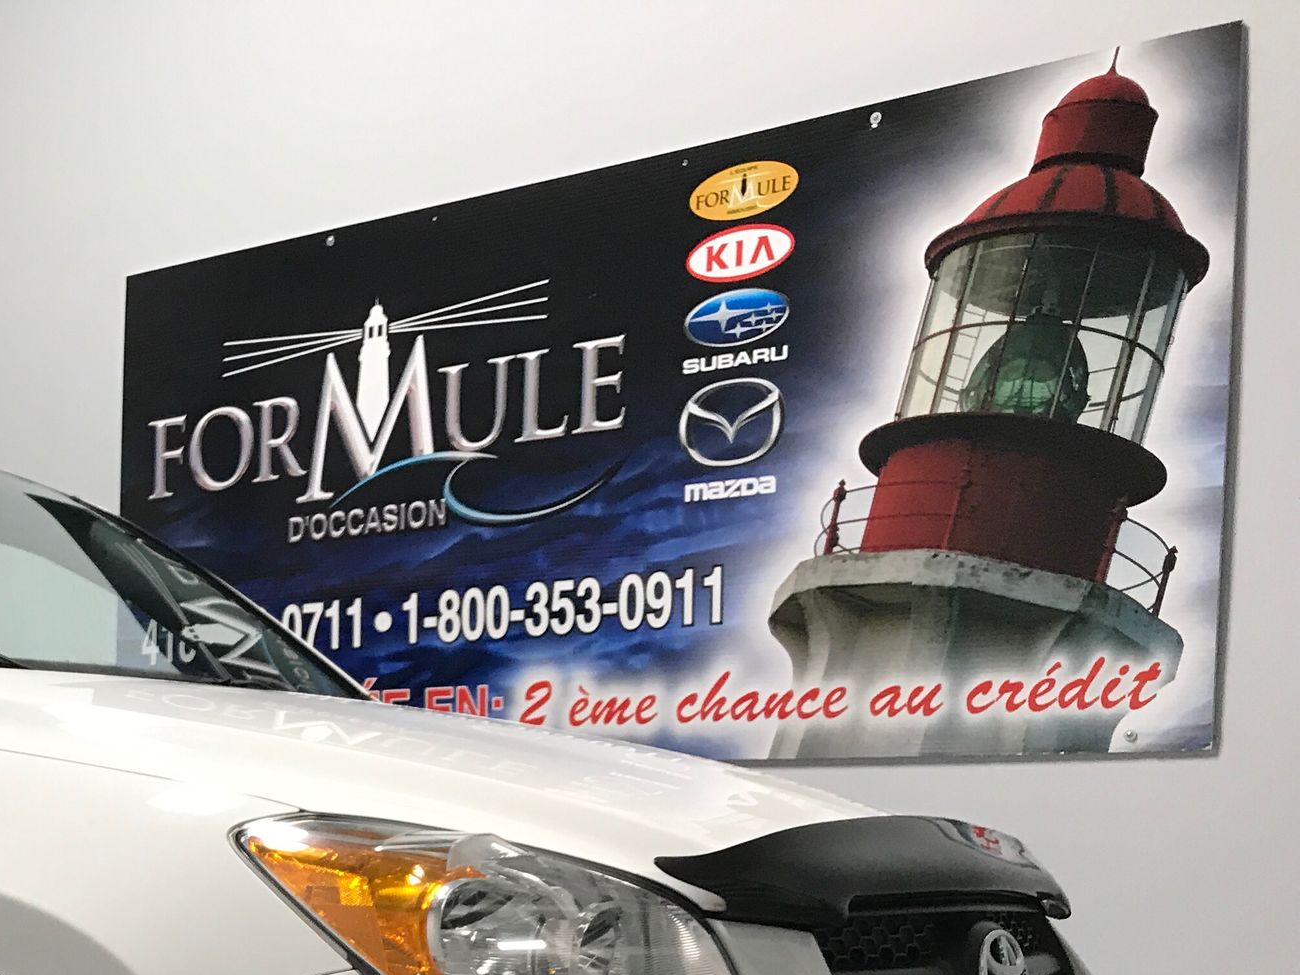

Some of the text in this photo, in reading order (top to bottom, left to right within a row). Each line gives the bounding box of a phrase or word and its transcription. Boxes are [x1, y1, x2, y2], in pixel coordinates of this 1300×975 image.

[695, 175, 791, 211] FORMULE
[706, 235, 775, 272] KIA
[682, 345, 788, 374] SUBARU
[147, 333, 626, 504] FORMULE
[288, 498, 447, 542] D'OCCASION
[401, 565, 724, 645] 1-800-353-0911
[519, 679, 553, 726] 2
[568, 684, 659, 727] ème
[676, 671, 849, 724] chance
[869, 683, 944, 718] au
[966, 656, 1162, 715] crédit
